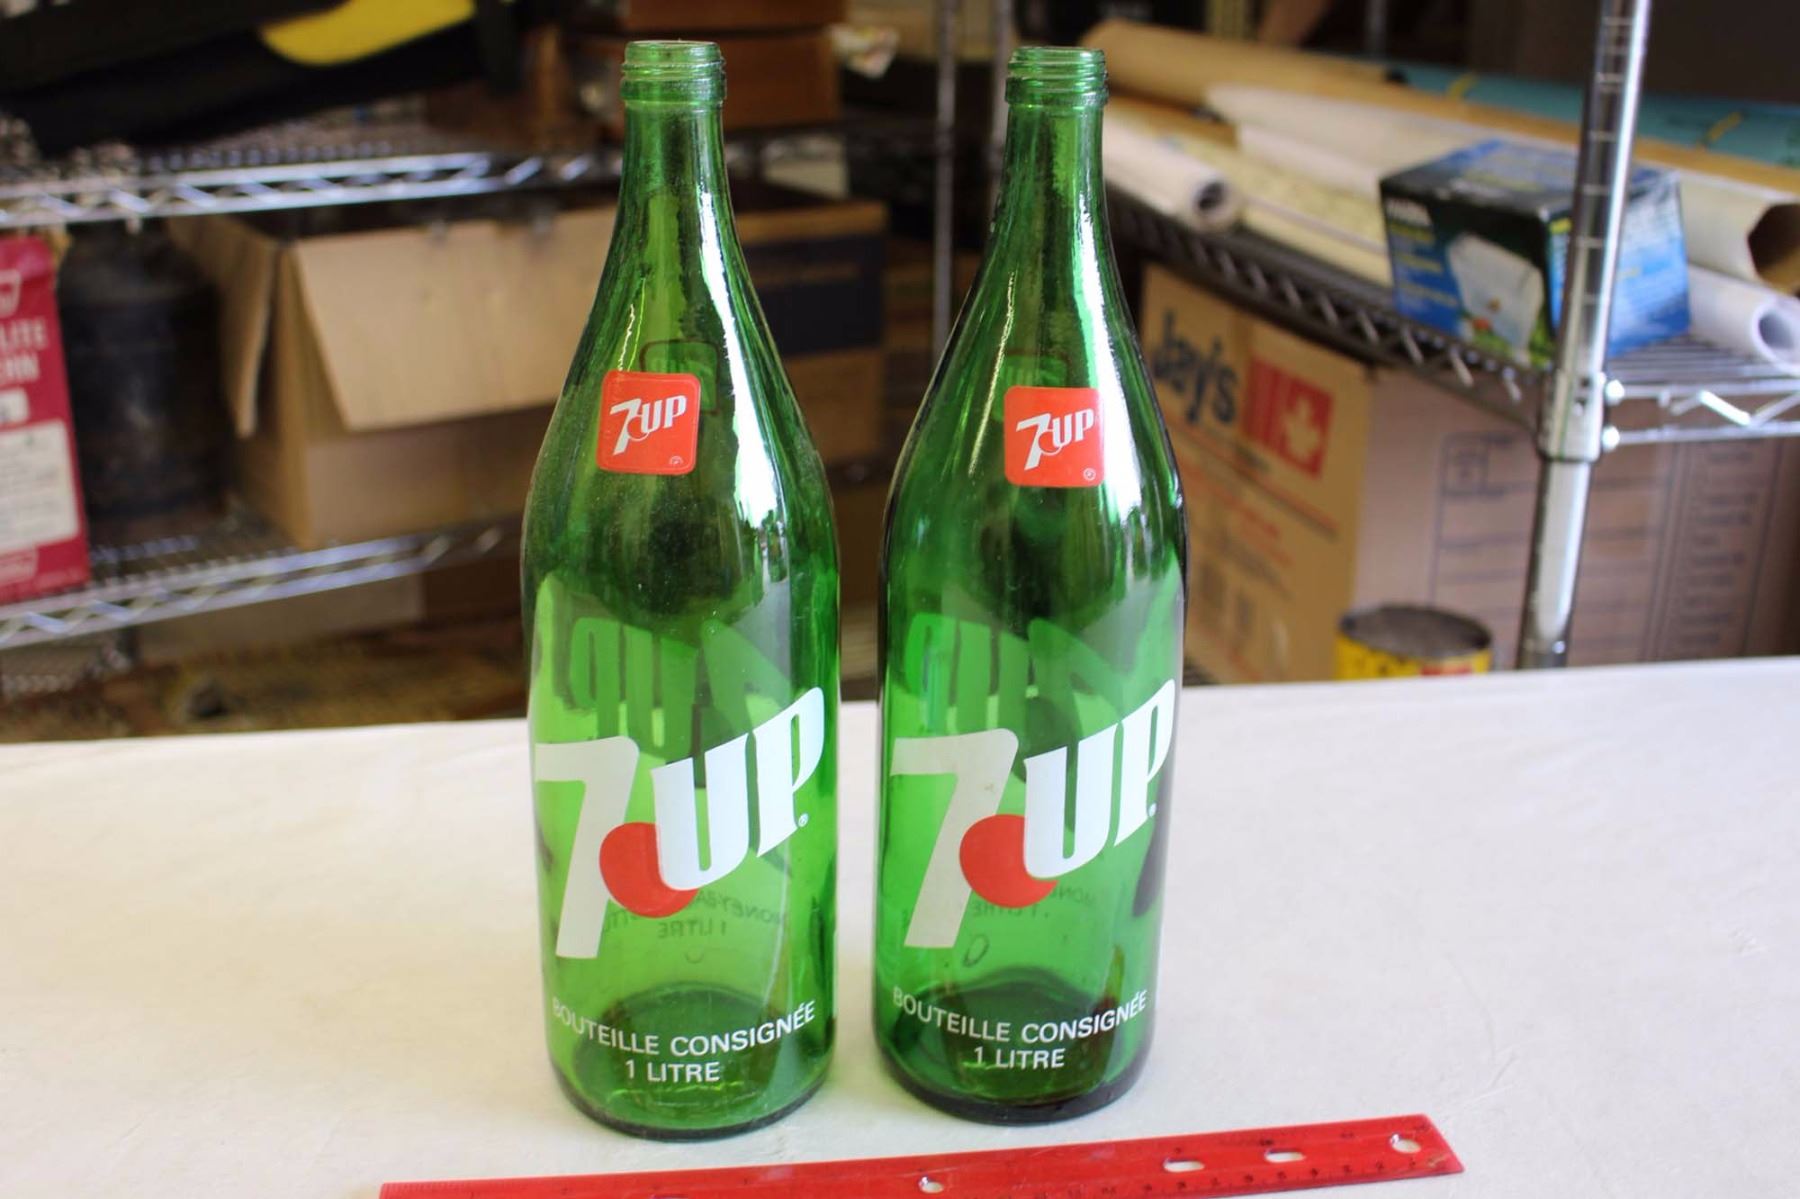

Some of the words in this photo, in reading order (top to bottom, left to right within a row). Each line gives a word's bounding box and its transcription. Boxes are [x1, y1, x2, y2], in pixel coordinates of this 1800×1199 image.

[609, 394, 687, 457] 7UP
[1015, 407, 1094, 472] 7UP
[552, 997, 660, 1055] BOUTEILLE
[670, 1000, 816, 1057] CONSIGNÉE
[893, 987, 1012, 1042] BOUTEILLE
[1021, 989, 1148, 1044] CONSIGNÉE
[625, 1059, 635, 1079] 1
[646, 1061, 721, 1083] LITRE
[973, 1046, 983, 1066] 1
[995, 1048, 1066, 1070] LITRE
